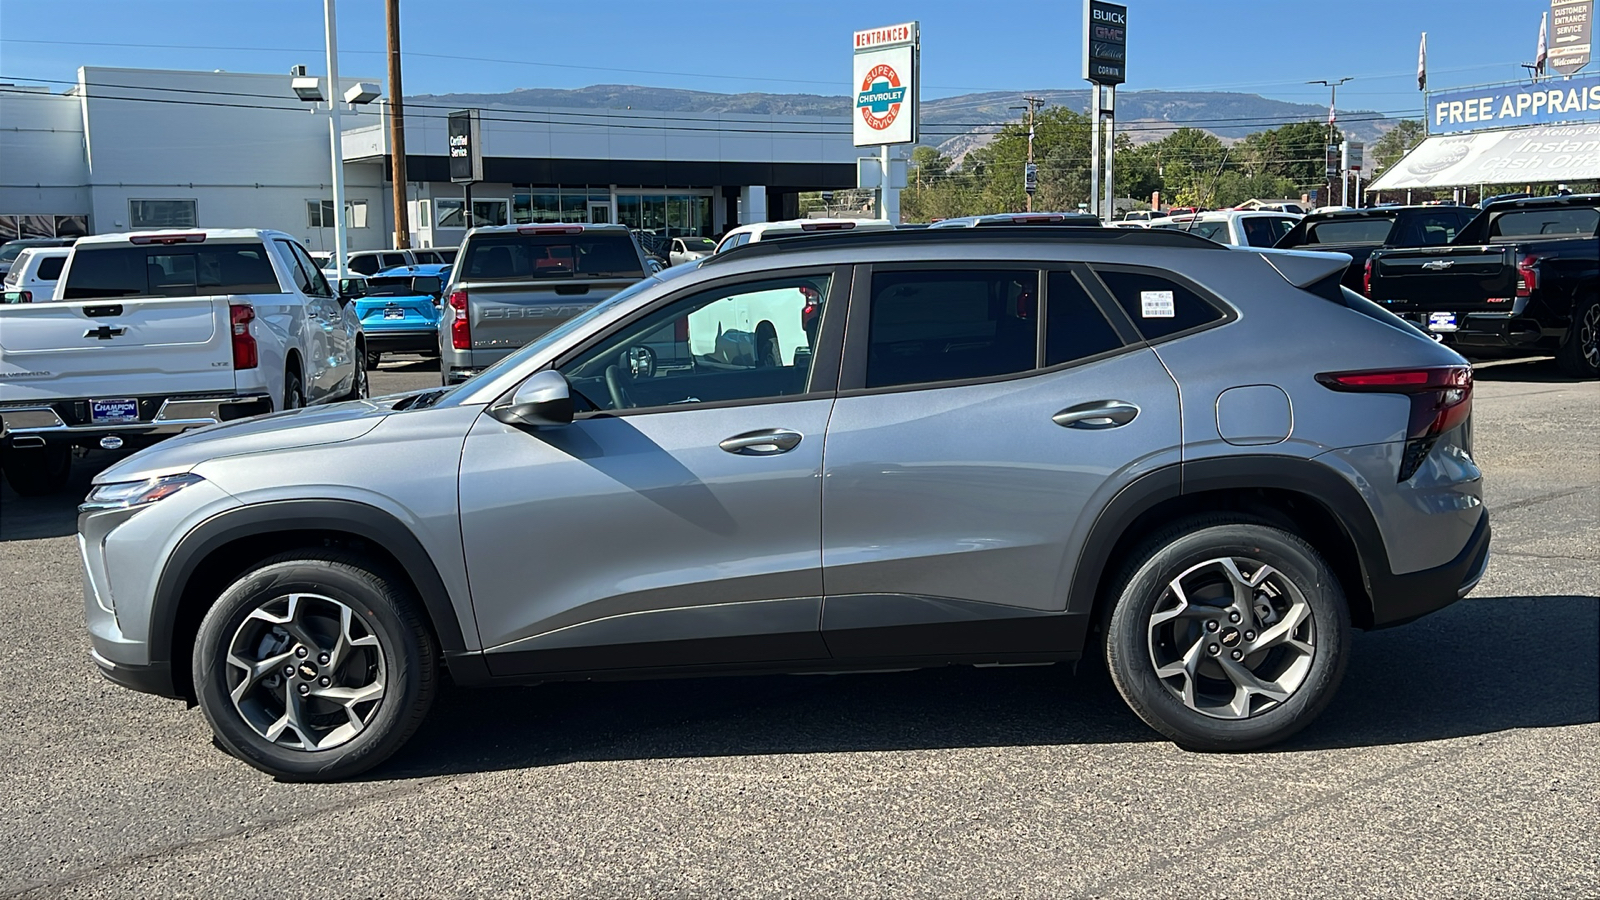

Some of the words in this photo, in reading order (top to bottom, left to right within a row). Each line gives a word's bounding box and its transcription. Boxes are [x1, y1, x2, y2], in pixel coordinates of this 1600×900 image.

[1093, 9, 1125, 24] BUICK
[1554, 5, 1588, 17] CUSTOMER
[1554, 14, 1587, 26] ENTRANCE
[861, 27, 903, 46] ENTRANCE
[1095, 26, 1124, 41] GMC
[1556, 25, 1583, 35] SERVICE
[1552, 55, 1584, 67] Welcome!
[866, 65, 895, 84] SUPER
[859, 91, 903, 104] CHEVROLET
[1436, 97, 1494, 126] FREE
[1498, 85, 1600, 119] APPRAIS
[863, 105, 898, 129] SERVICE
[1541, 127, 1583, 138] Kelley
[1584, 126, 1600, 135] Bl
[451, 147, 467, 157] Service
[1515, 139, 1600, 153] Instan
[1478, 154, 1543, 170] Cash
[94, 403, 135, 412] CHAMPION
